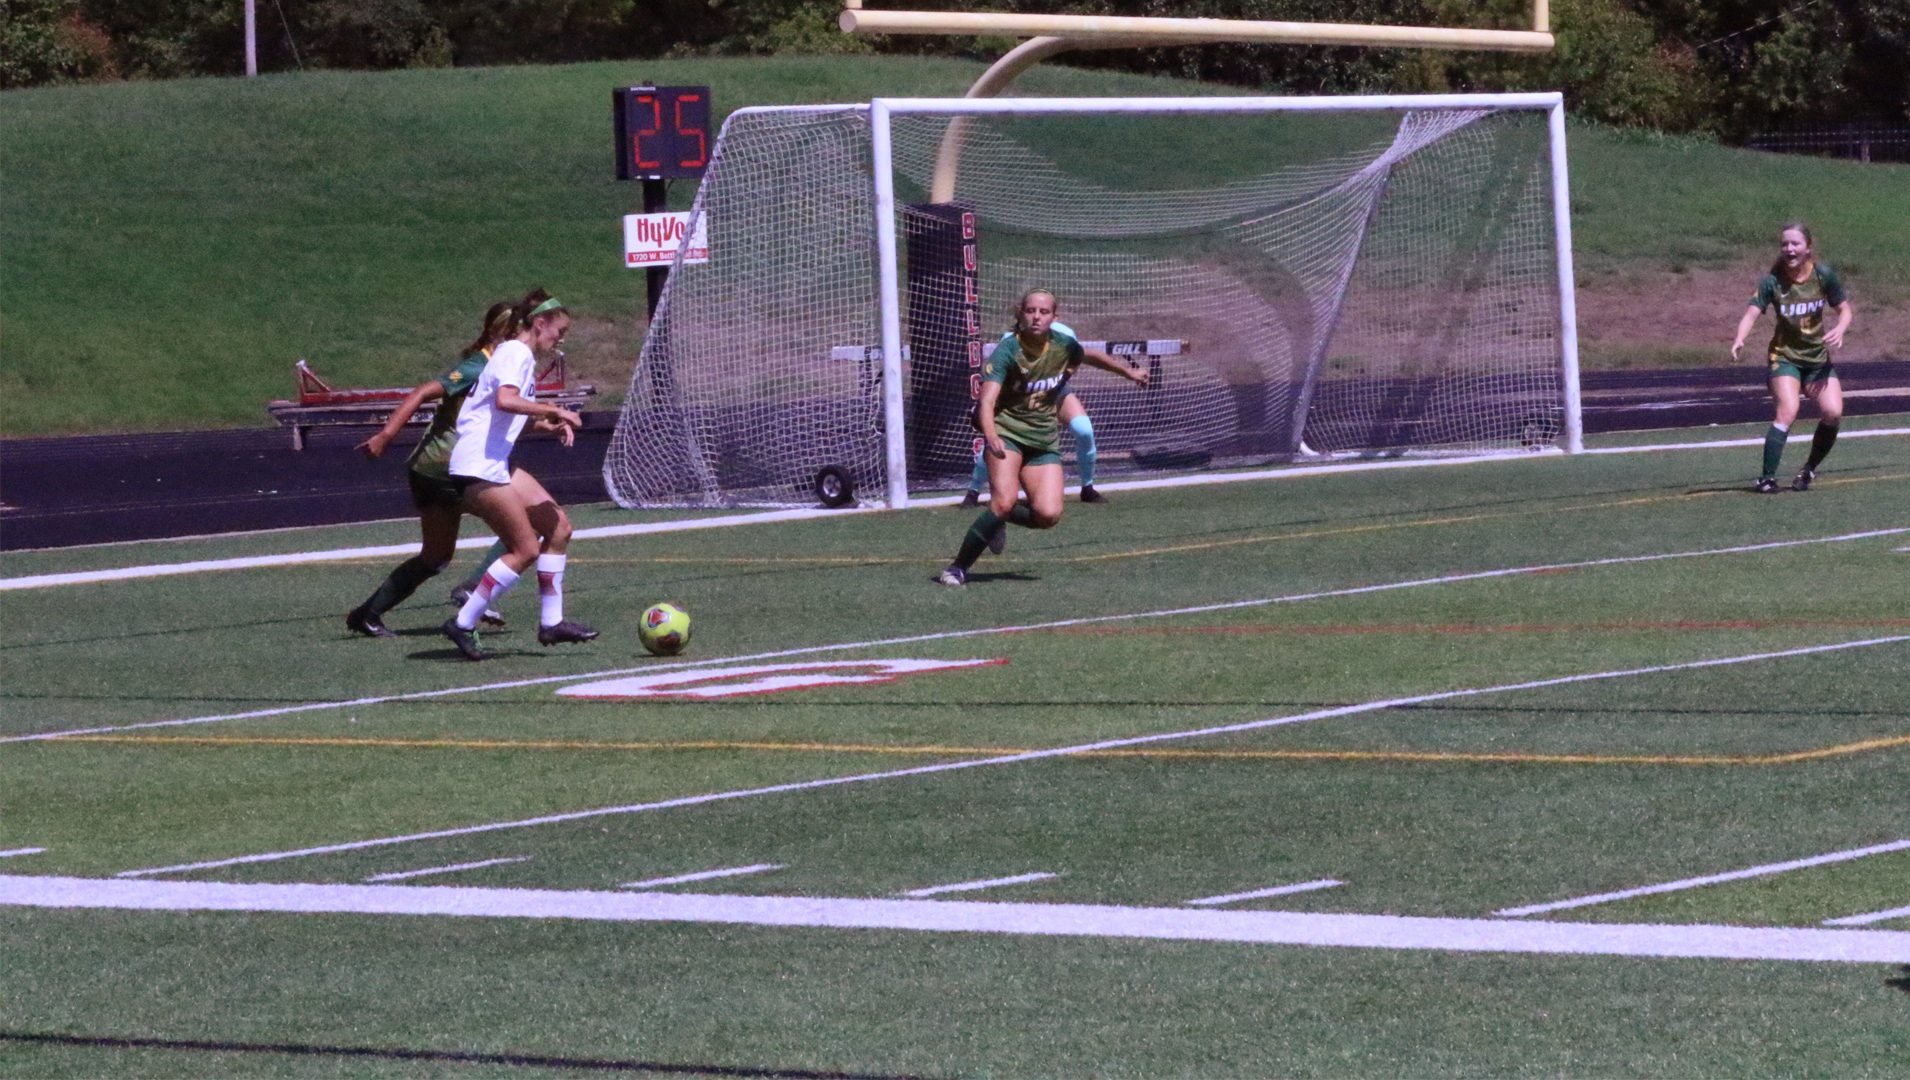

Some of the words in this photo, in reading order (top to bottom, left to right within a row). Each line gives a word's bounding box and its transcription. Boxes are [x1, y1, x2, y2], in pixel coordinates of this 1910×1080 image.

[634, 95, 706, 168] 25
[632, 253, 648, 261] 1720
[1112, 343, 1141, 355] GILL
